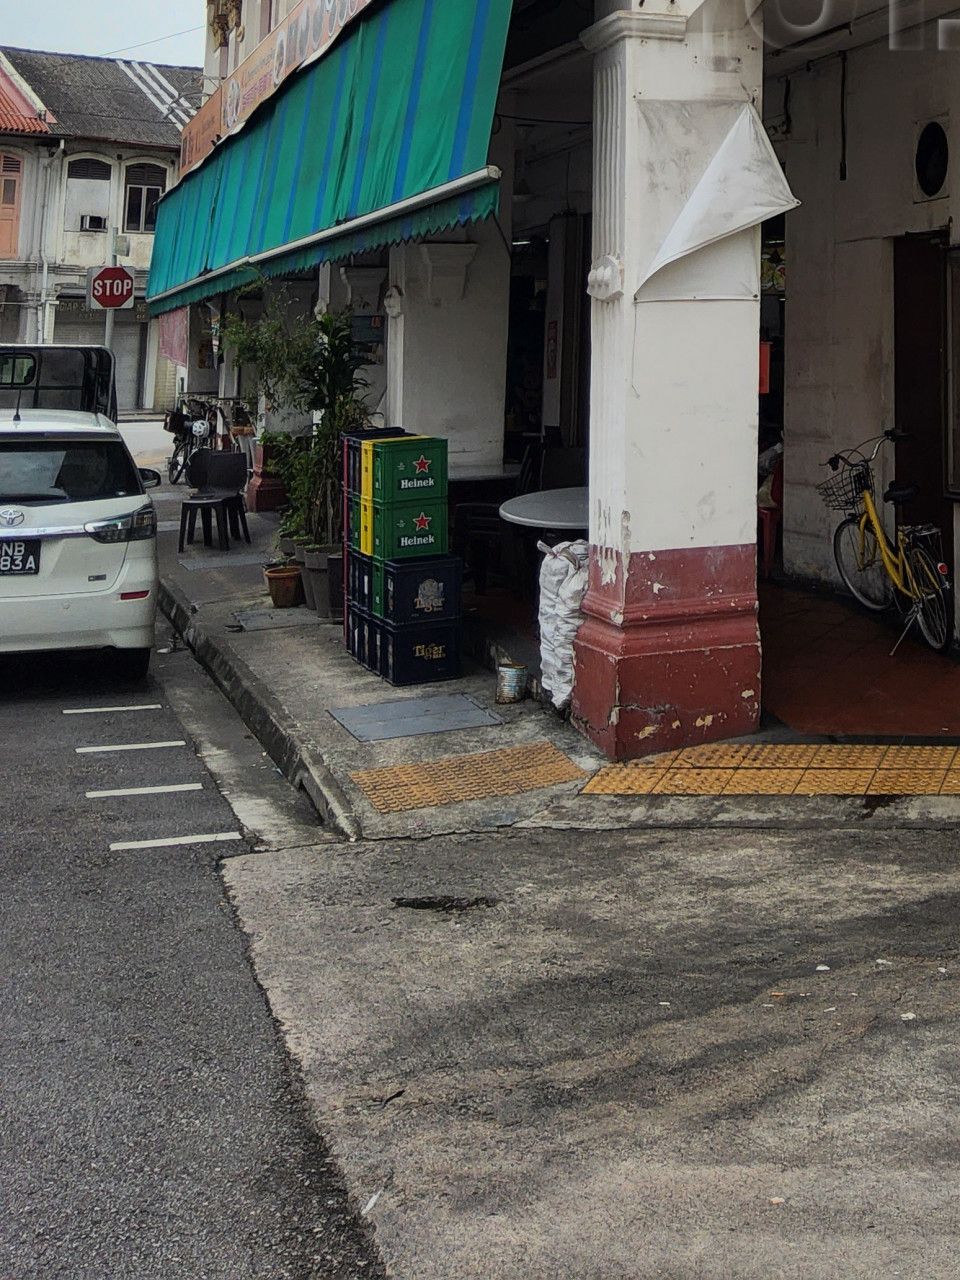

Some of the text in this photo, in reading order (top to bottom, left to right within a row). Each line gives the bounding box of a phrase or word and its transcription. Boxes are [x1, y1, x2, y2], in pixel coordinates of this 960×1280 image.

[93, 278, 133, 296] STOP
[400, 477, 435, 489] Heinek
[400, 534, 435, 547] Heinek
[0, 542, 25, 556] NB
